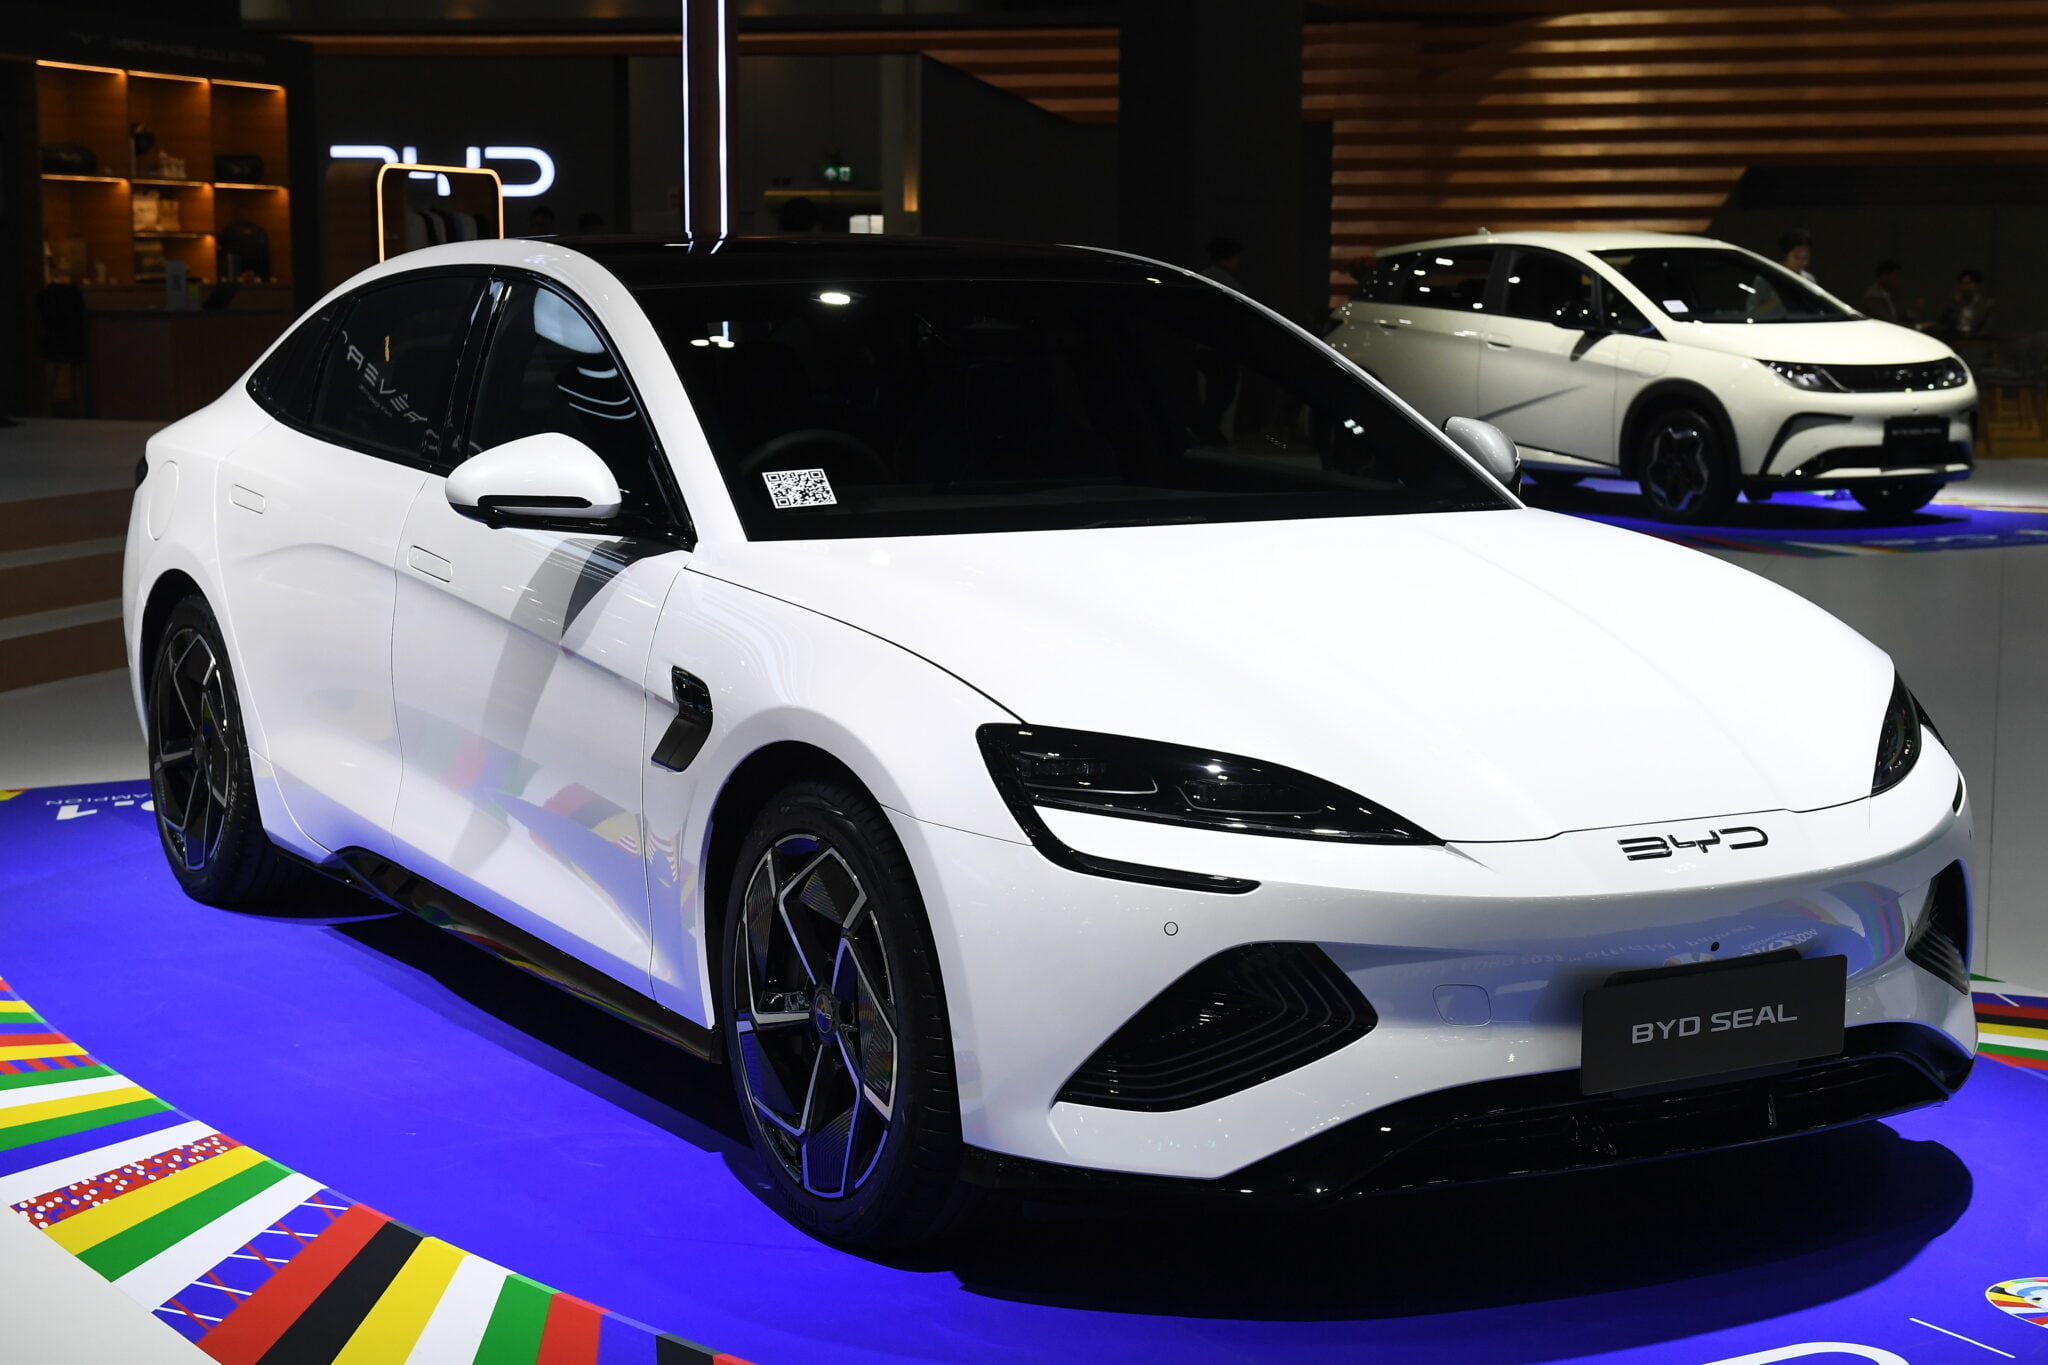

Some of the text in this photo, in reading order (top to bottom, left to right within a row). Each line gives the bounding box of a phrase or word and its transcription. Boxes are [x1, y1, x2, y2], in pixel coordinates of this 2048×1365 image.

[46, 793, 153, 806] AMPION
[1617, 826, 1769, 861] BYD
[1632, 1004, 1798, 1044] BYD SEAL
